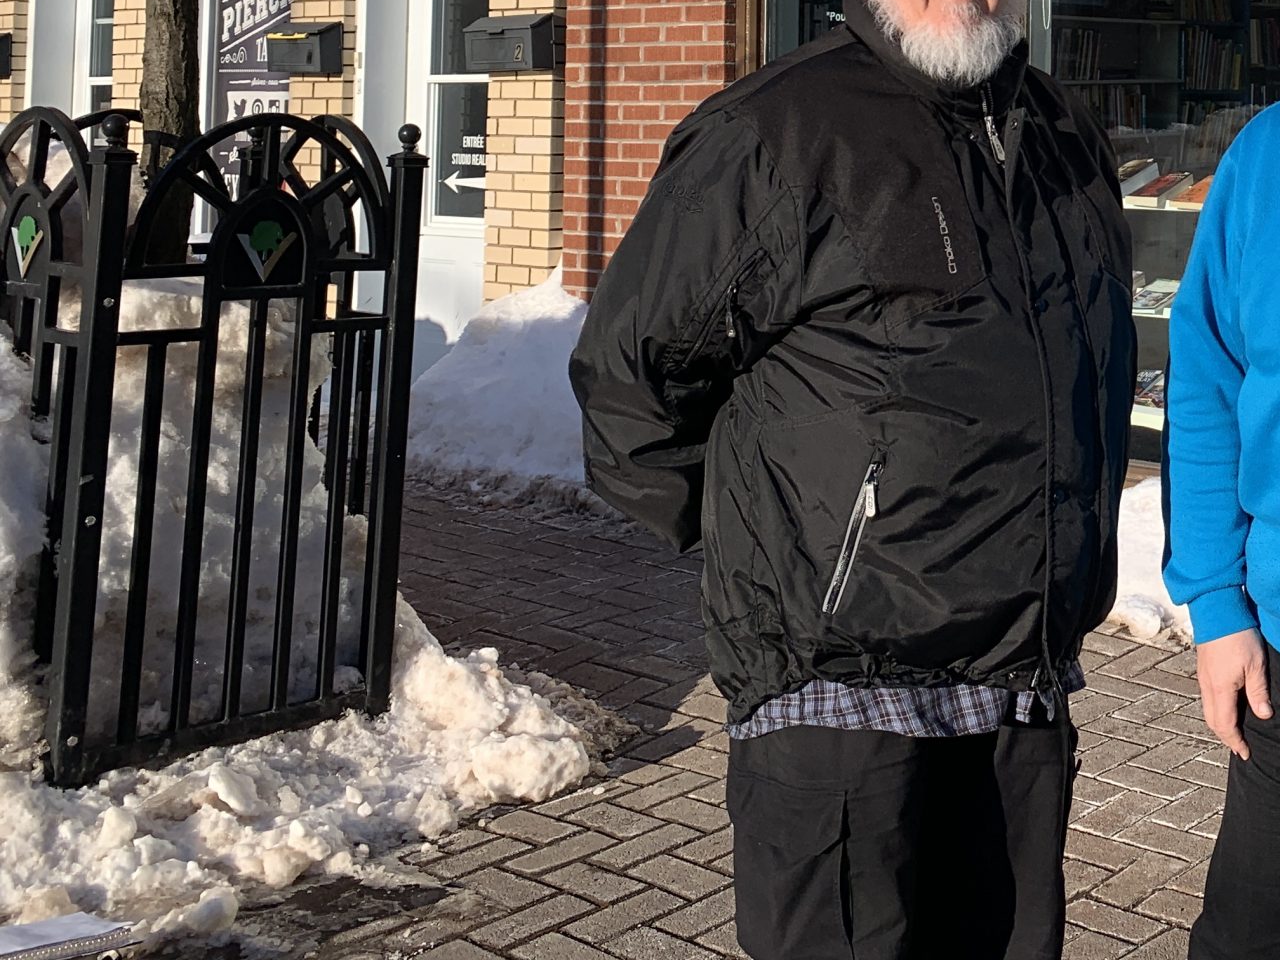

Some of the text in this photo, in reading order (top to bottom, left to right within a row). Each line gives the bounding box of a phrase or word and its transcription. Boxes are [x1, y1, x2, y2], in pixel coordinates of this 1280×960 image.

[514, 44, 523, 61] 2
[463, 134, 484, 149] ENTRÉE
[451, 153, 472, 166] STUDIO
